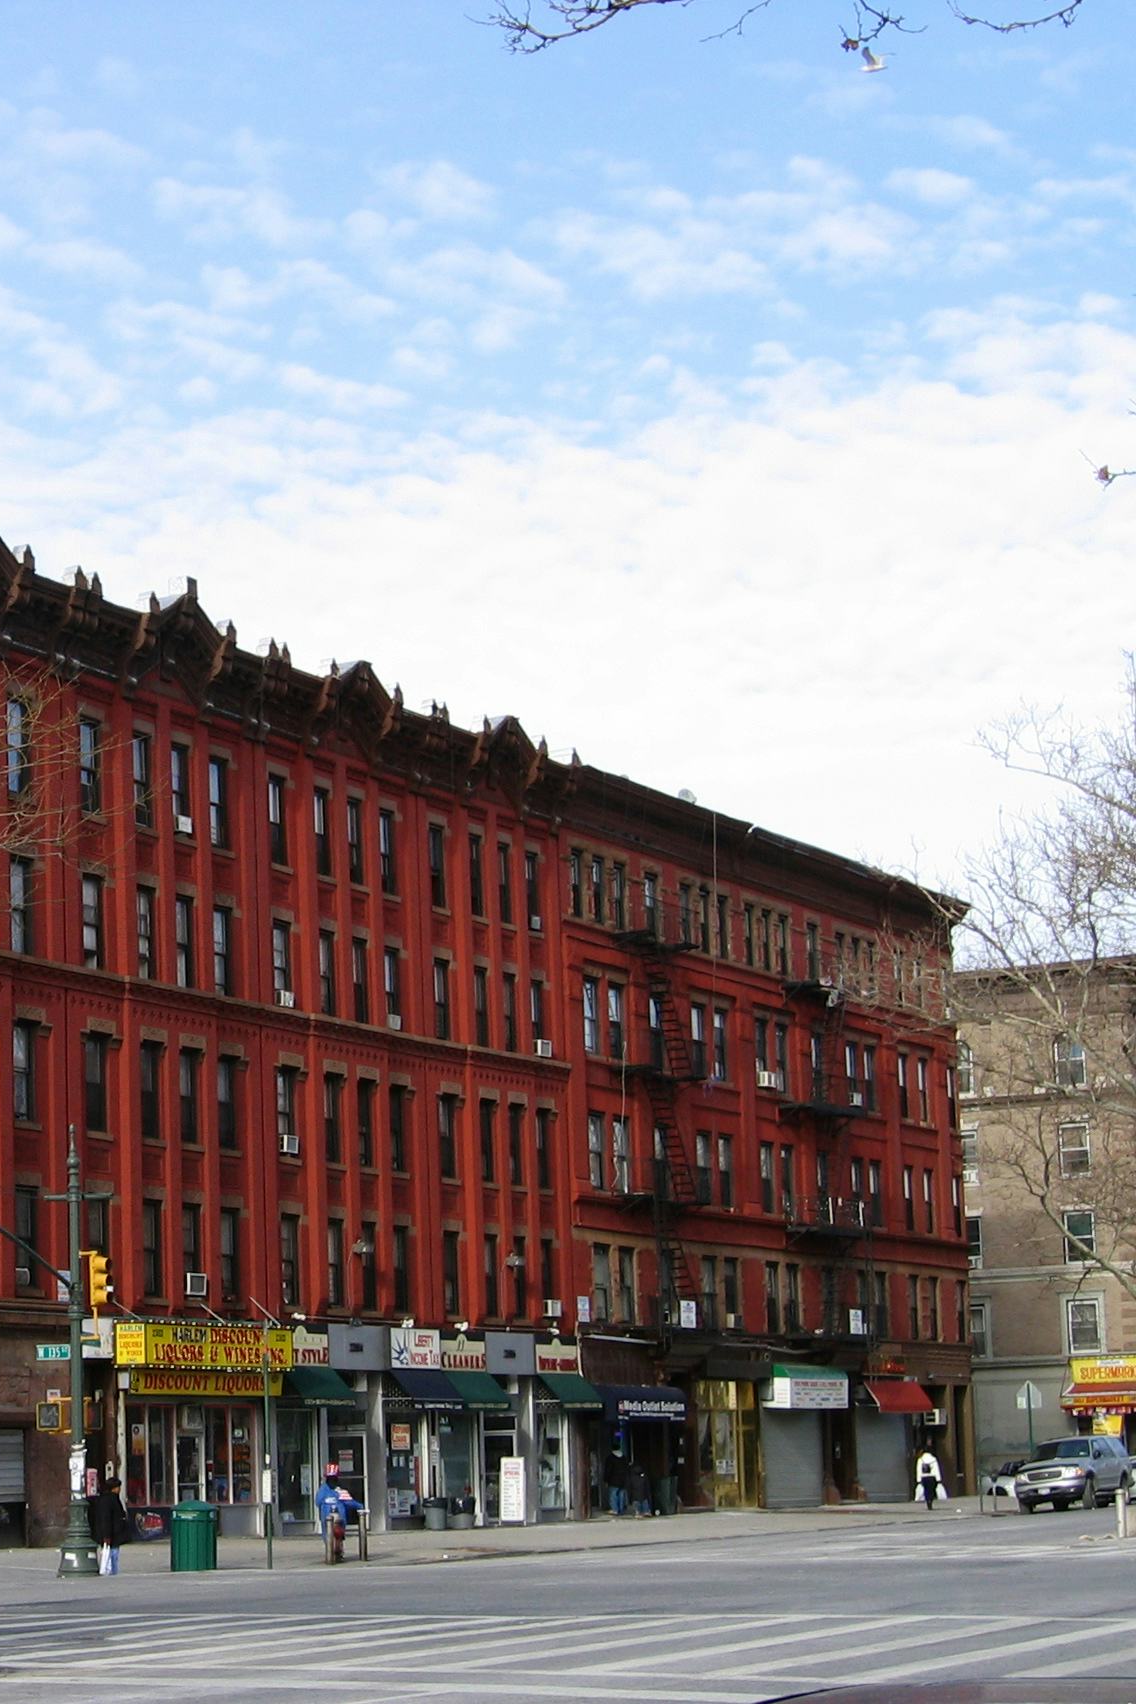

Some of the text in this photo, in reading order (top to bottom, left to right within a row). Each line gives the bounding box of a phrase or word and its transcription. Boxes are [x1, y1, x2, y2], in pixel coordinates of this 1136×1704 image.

[172, 1327, 207, 1343] HARLEM
[154, 1343, 204, 1363] LIQUORS
[224, 1347, 260, 1364] WINES
[264, 1347, 288, 1365] NC.
[302, 1348, 328, 1364] STYLE
[441, 1351, 486, 1369] CLEANERS
[144, 1372, 210, 1391] DISCOUNT
